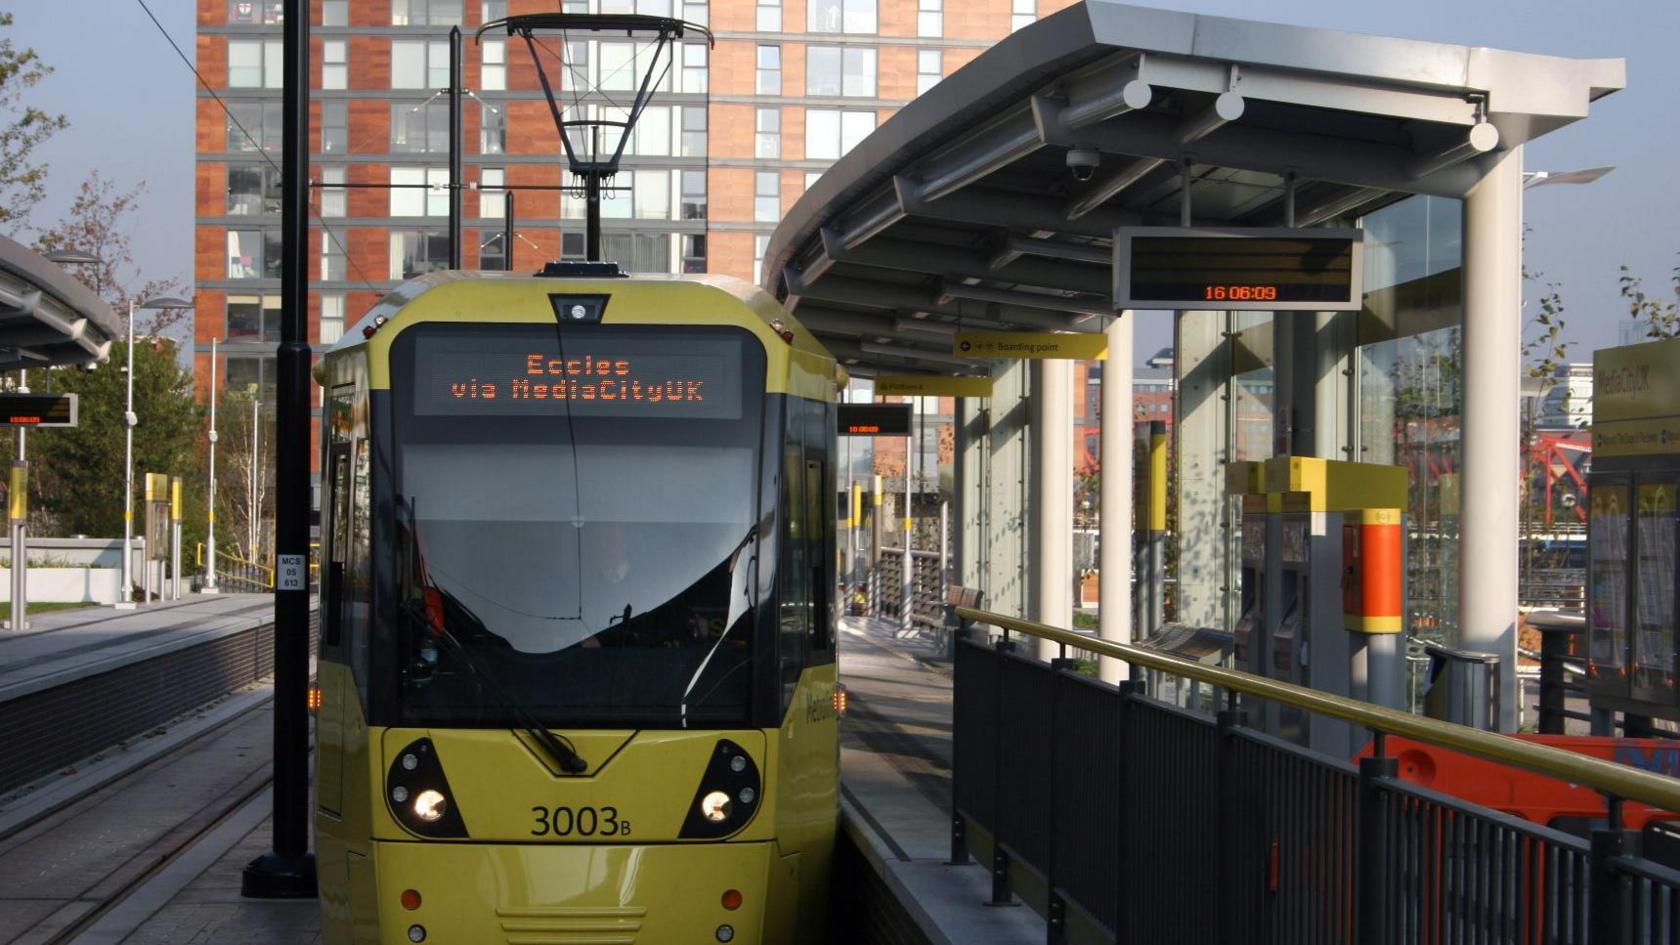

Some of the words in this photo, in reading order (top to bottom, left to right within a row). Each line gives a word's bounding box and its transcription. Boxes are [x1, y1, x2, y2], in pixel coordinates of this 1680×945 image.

[1205, 286, 1226, 300] 16
[1229, 286, 1277, 300] 06:09
[998, 343, 1034, 353] Boarding
[1037, 343, 1059, 353] point
[527, 353, 631, 375] Eccles
[450, 377, 497, 399] via
[512, 377, 705, 402] MediaCityUK
[282, 557, 301, 565] MCS
[286, 568, 297, 576] 05
[284, 579, 298, 587] 613
[531, 806, 632, 836] 3003B
